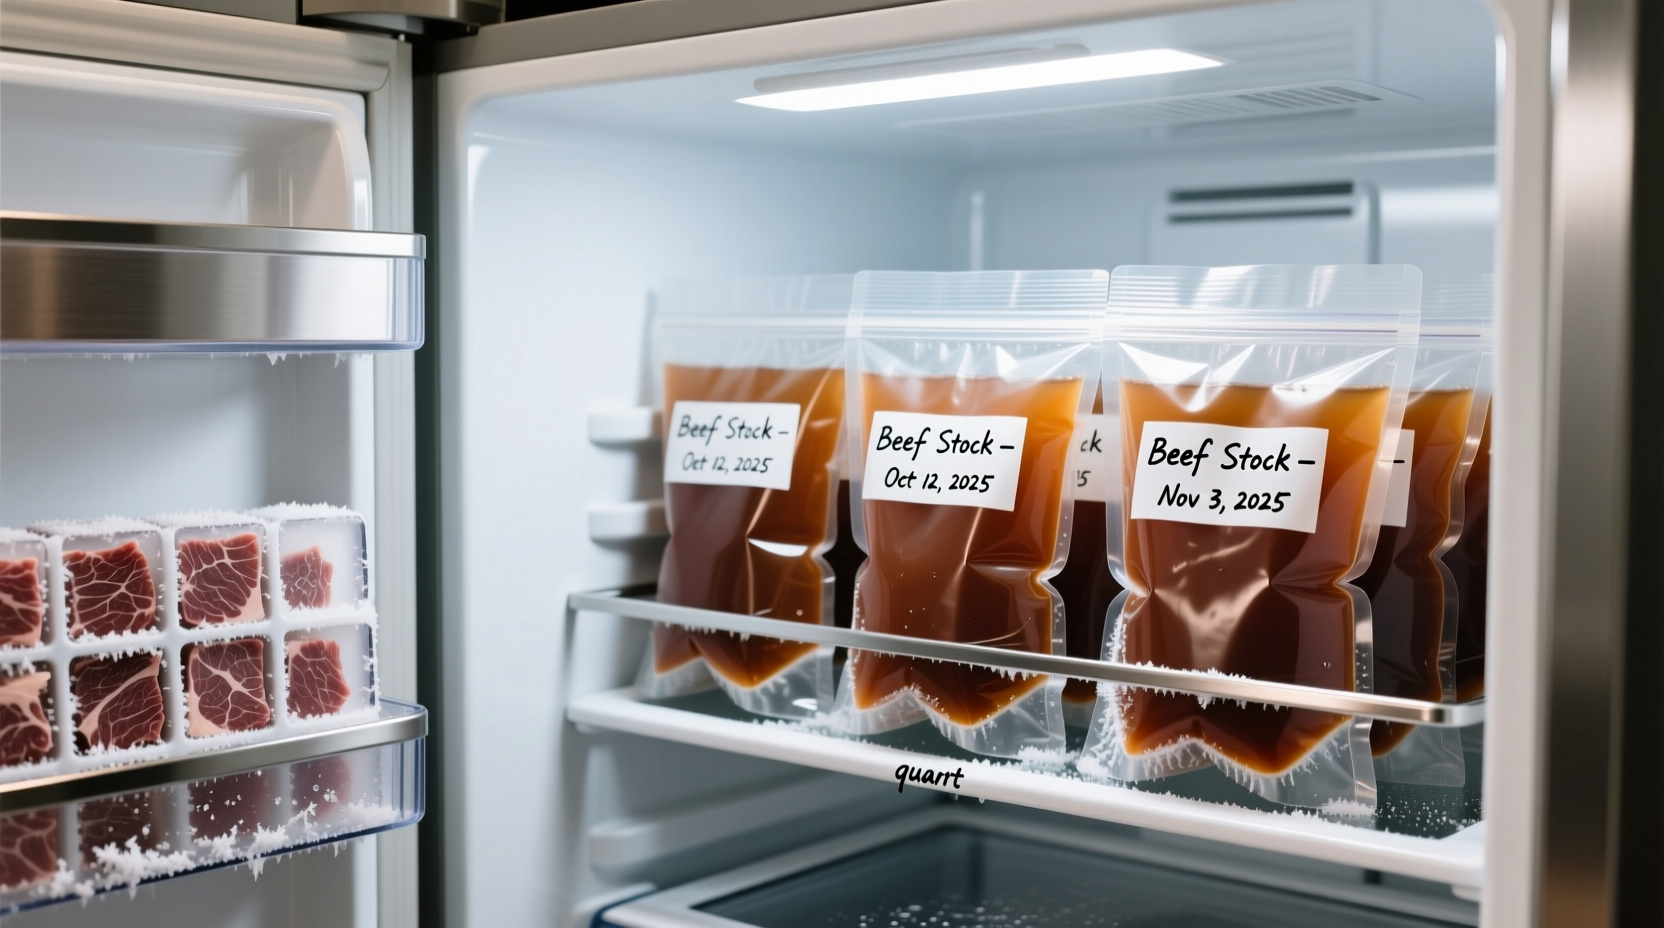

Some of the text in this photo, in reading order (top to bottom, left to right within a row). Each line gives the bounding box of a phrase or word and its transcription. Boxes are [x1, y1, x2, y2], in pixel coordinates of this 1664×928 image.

[677, 414, 722, 446] Beef
[725, 416, 772, 440] Stock
[876, 425, 931, 461] Beef
[936, 428, 994, 456] Stock
[712, 456, 729, 475] 12,
[734, 457, 774, 474] 2025
[1147, 437, 1214, 477] Beef
[1220, 442, 1291, 472] Stock
[884, 466, 995, 494] Oct 12, 2025
[1157, 482, 1292, 515] Nov 3, 2025
